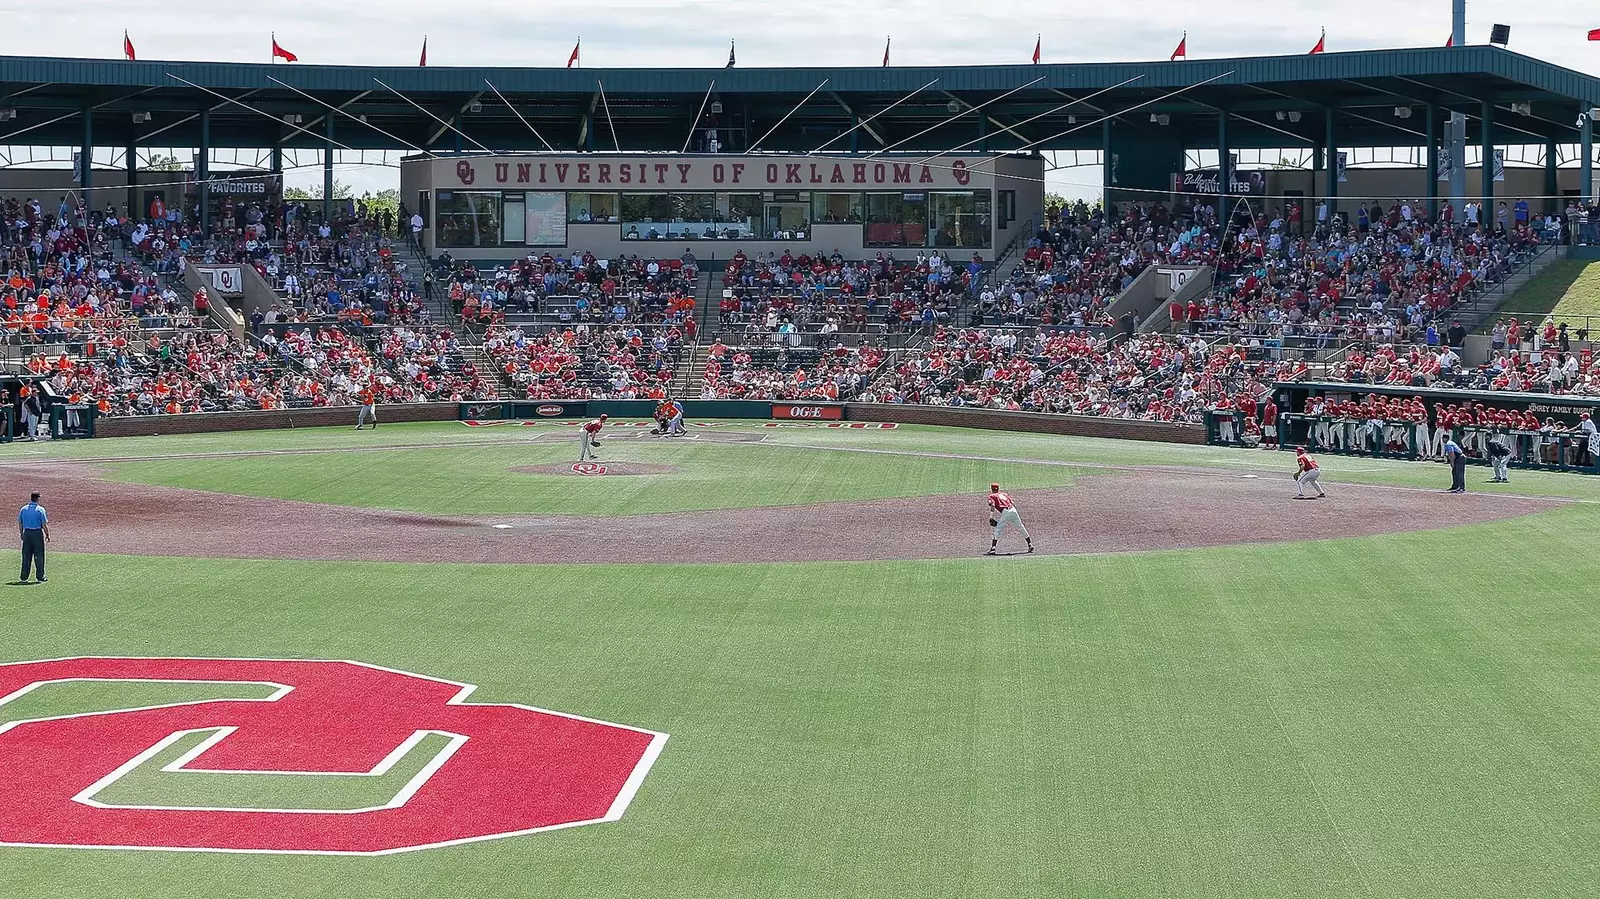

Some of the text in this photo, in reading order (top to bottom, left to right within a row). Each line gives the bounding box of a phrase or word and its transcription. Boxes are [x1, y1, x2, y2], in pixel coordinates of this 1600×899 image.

[457, 160, 475, 185] OU
[495, 163, 934, 183] UNIVERSITY OF OKLAHOMA
[952, 160, 971, 185] OU
[211, 182, 266, 193] FAVORITES
[1199, 182, 1250, 193] FAVITES
[221, 270, 232, 288] OU
